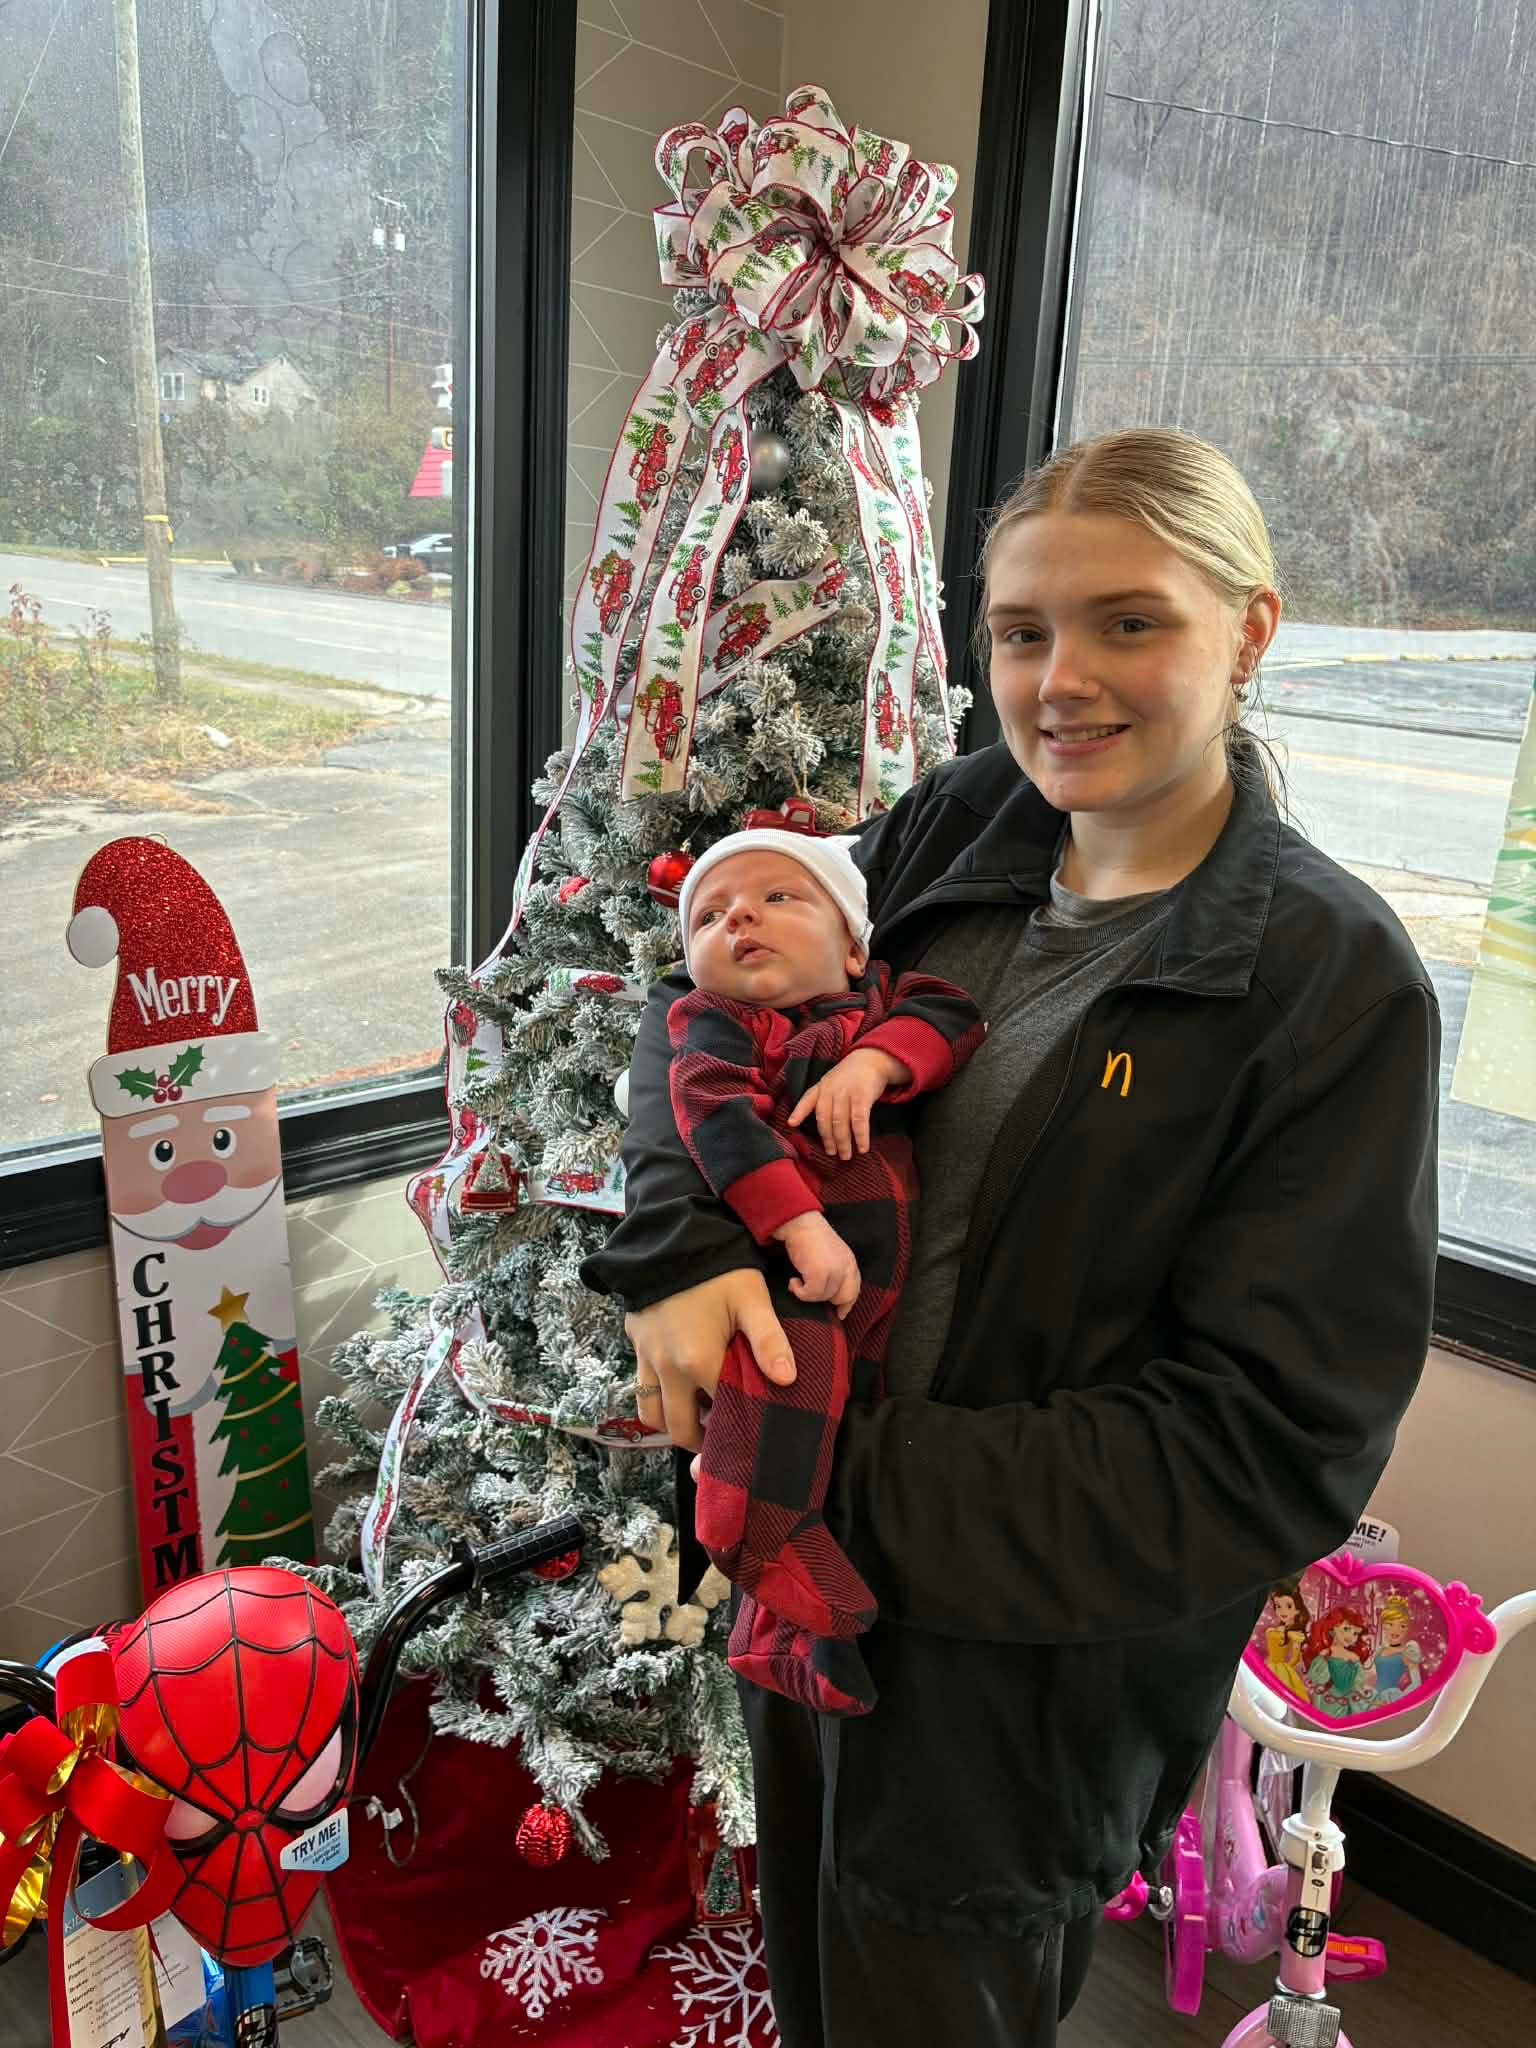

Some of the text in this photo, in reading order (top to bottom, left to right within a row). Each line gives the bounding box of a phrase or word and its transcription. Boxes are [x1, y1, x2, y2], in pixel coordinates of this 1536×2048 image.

[127, 967, 239, 1026] Merry
[291, 1835, 315, 1863] TRY
[318, 1818, 341, 1846] ME!
